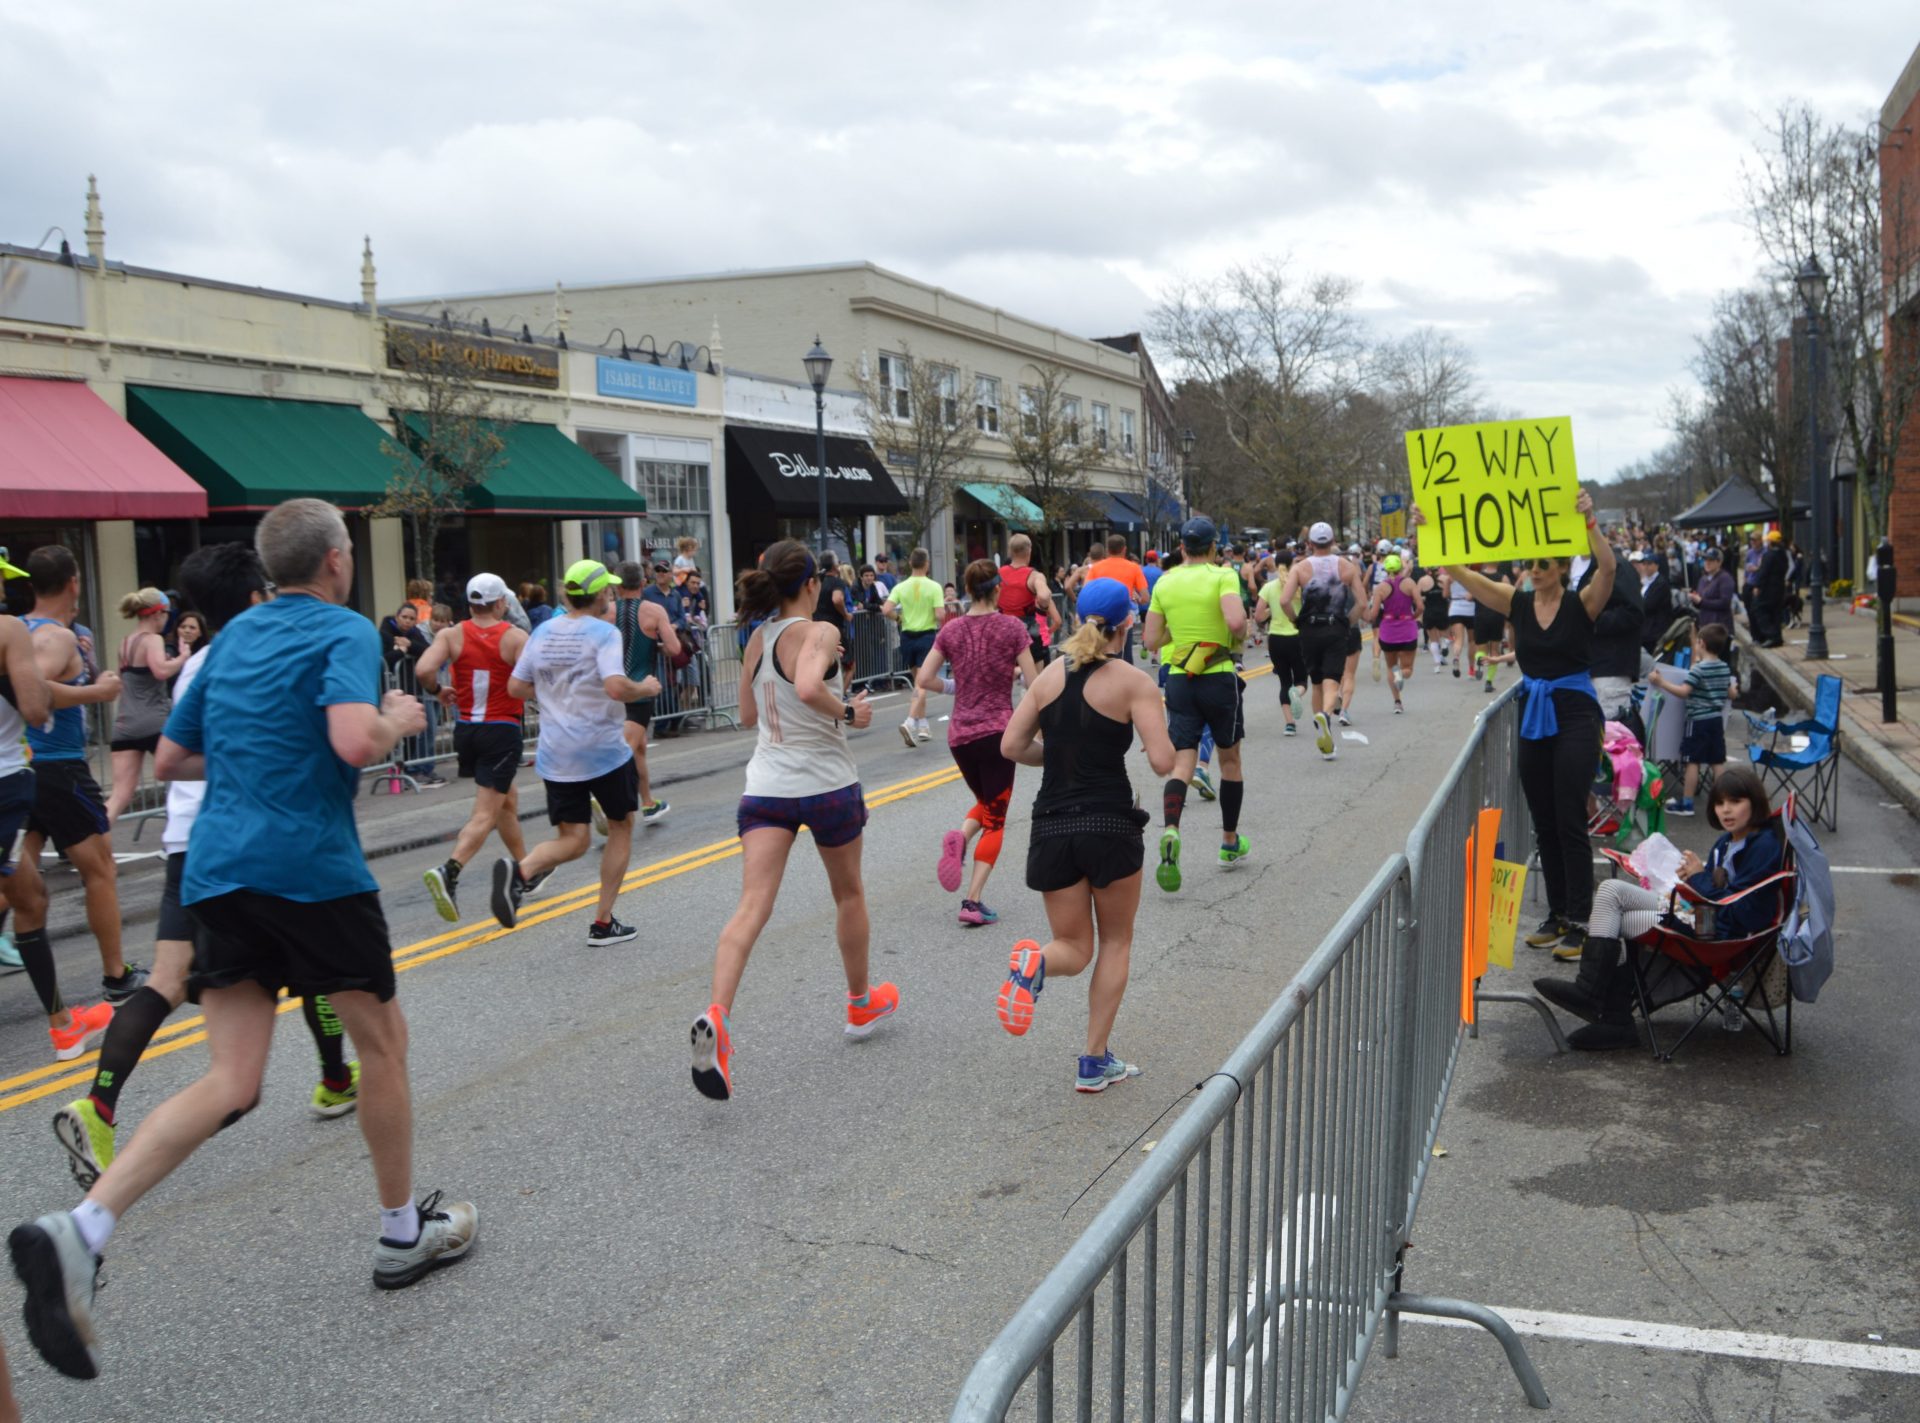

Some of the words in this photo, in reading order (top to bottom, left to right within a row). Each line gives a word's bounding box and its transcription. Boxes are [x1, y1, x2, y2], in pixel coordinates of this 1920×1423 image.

[605, 368, 645, 389] ISABEL
[648, 375, 692, 396] HARVEY
[768, 452, 840, 478] Dellaa
[1476, 425, 1559, 479] WAY
[1436, 486, 1572, 556] HOME
[645, 537, 672, 549] ISABEL
